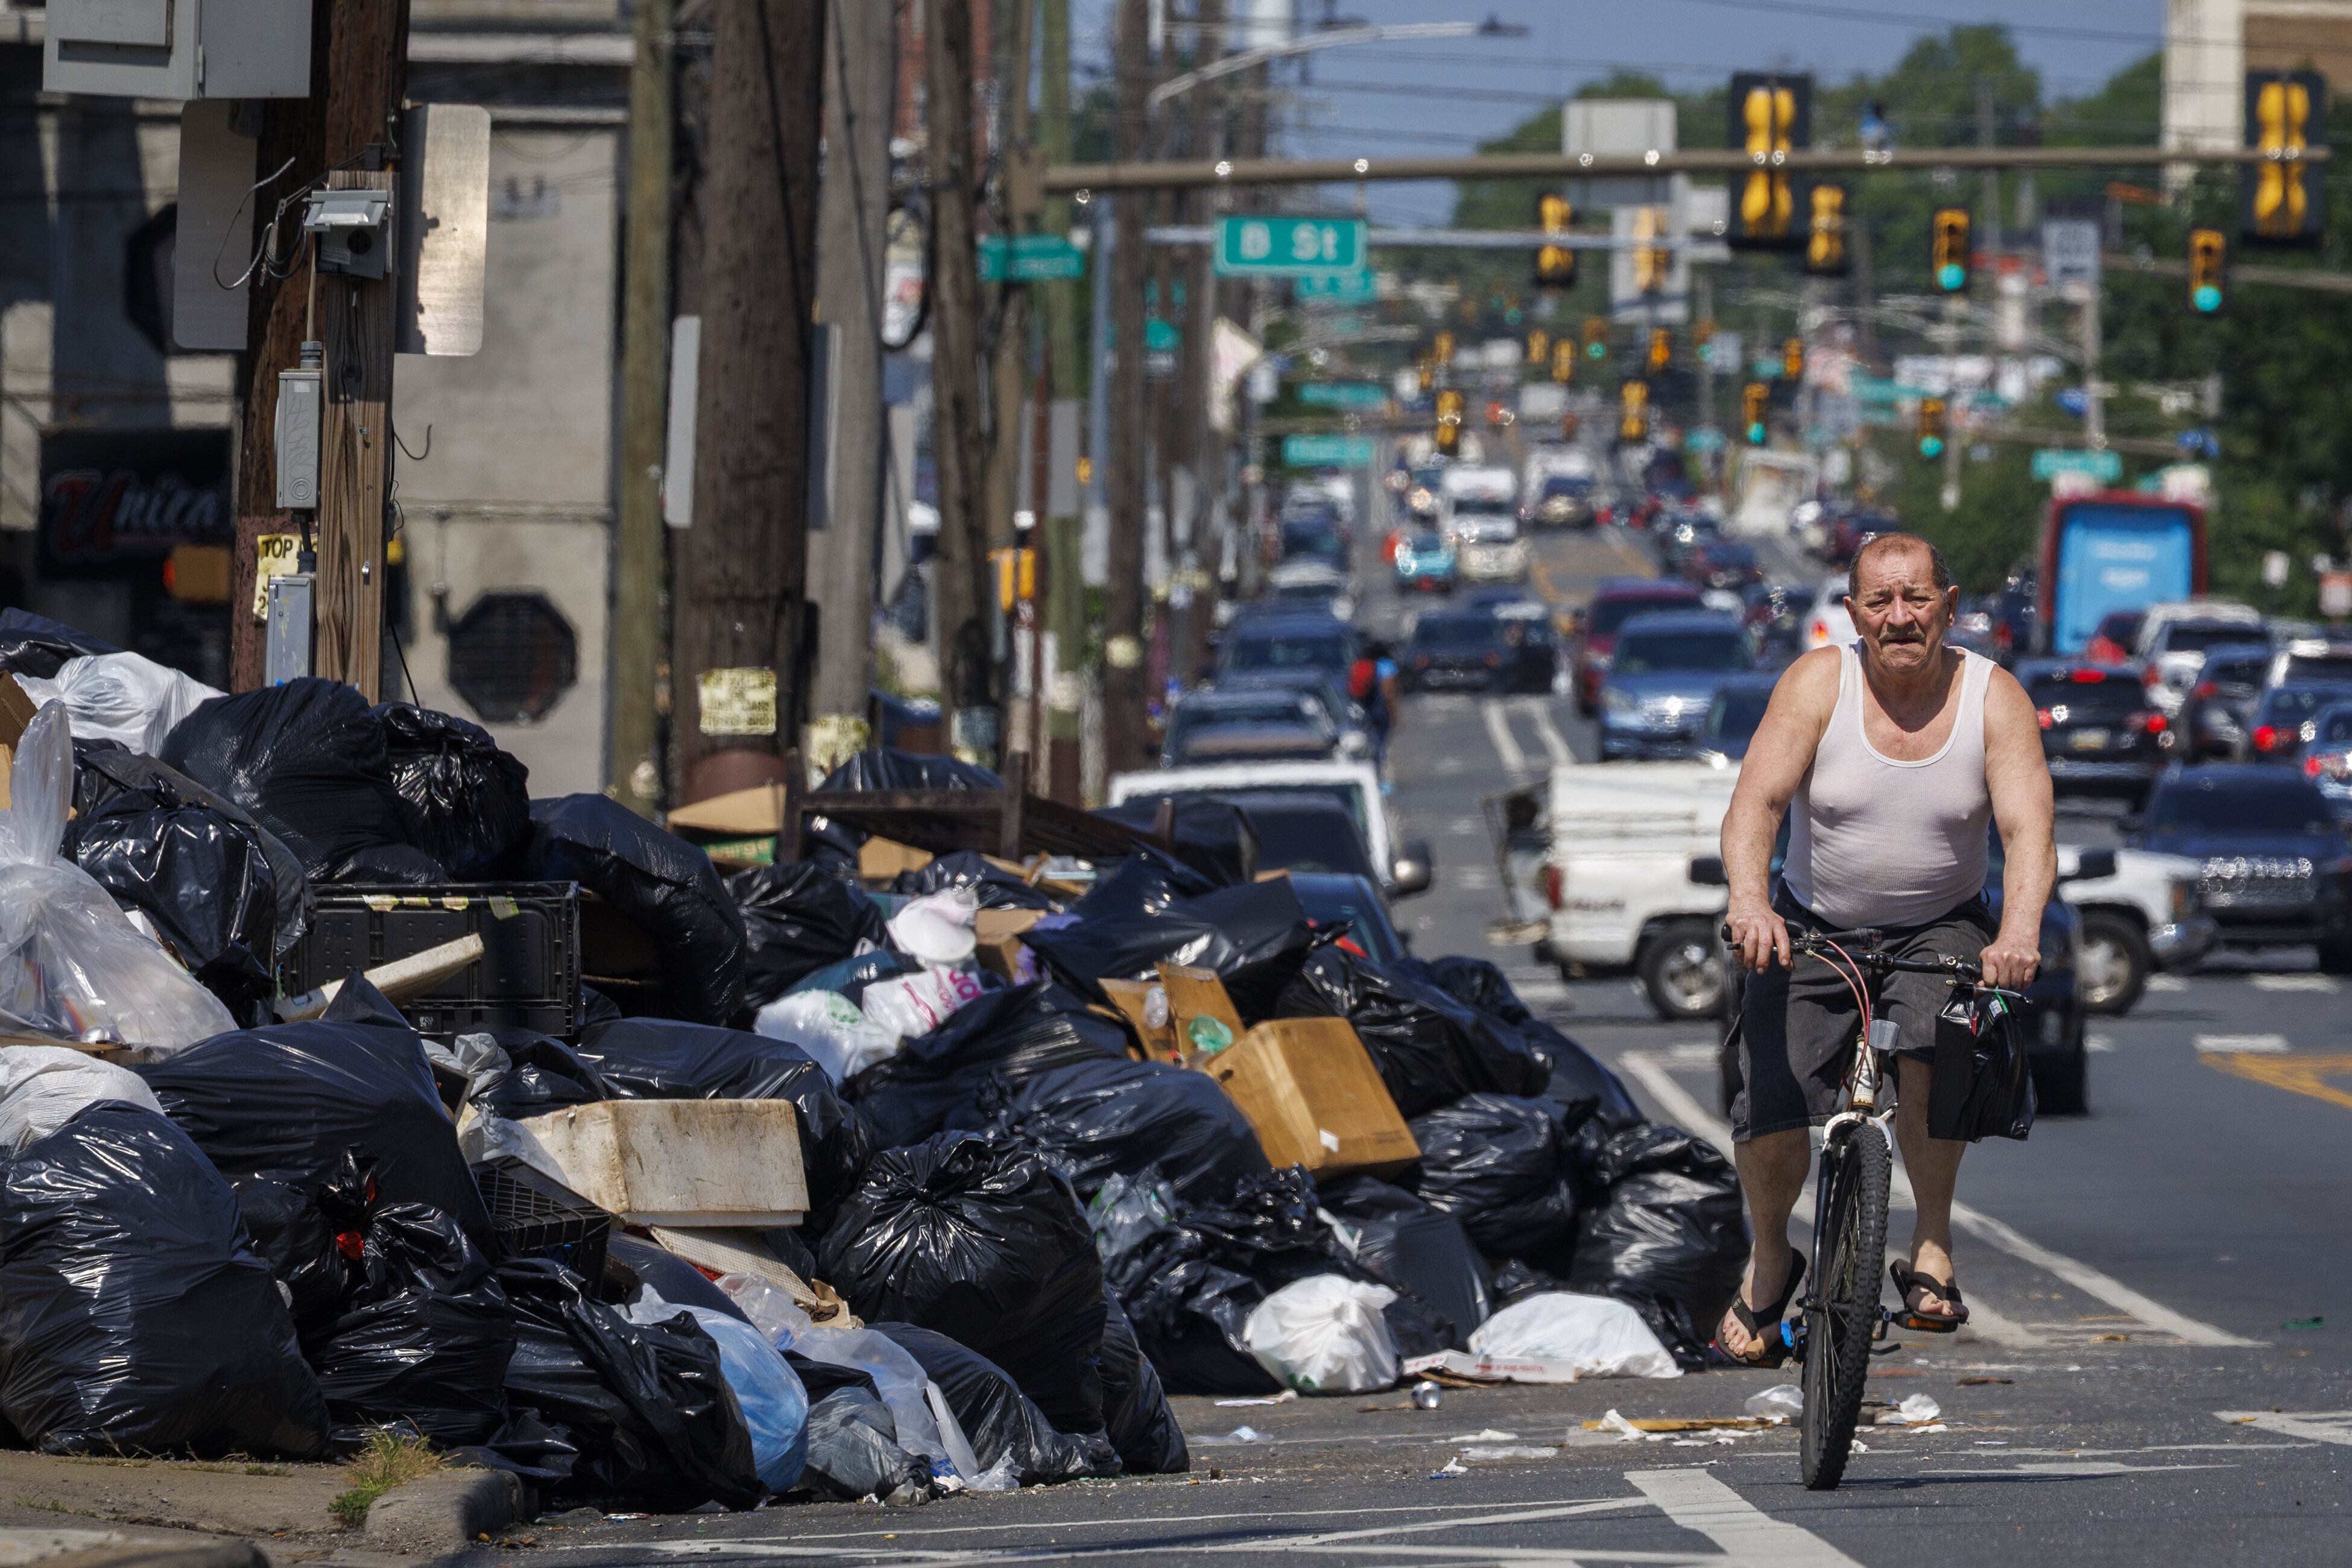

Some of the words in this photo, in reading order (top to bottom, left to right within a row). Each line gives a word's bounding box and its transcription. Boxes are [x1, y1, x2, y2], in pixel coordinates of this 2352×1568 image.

[1240, 221, 1271, 260] B
[1292, 222, 1339, 260] St
[262, 536, 293, 559] TOP
